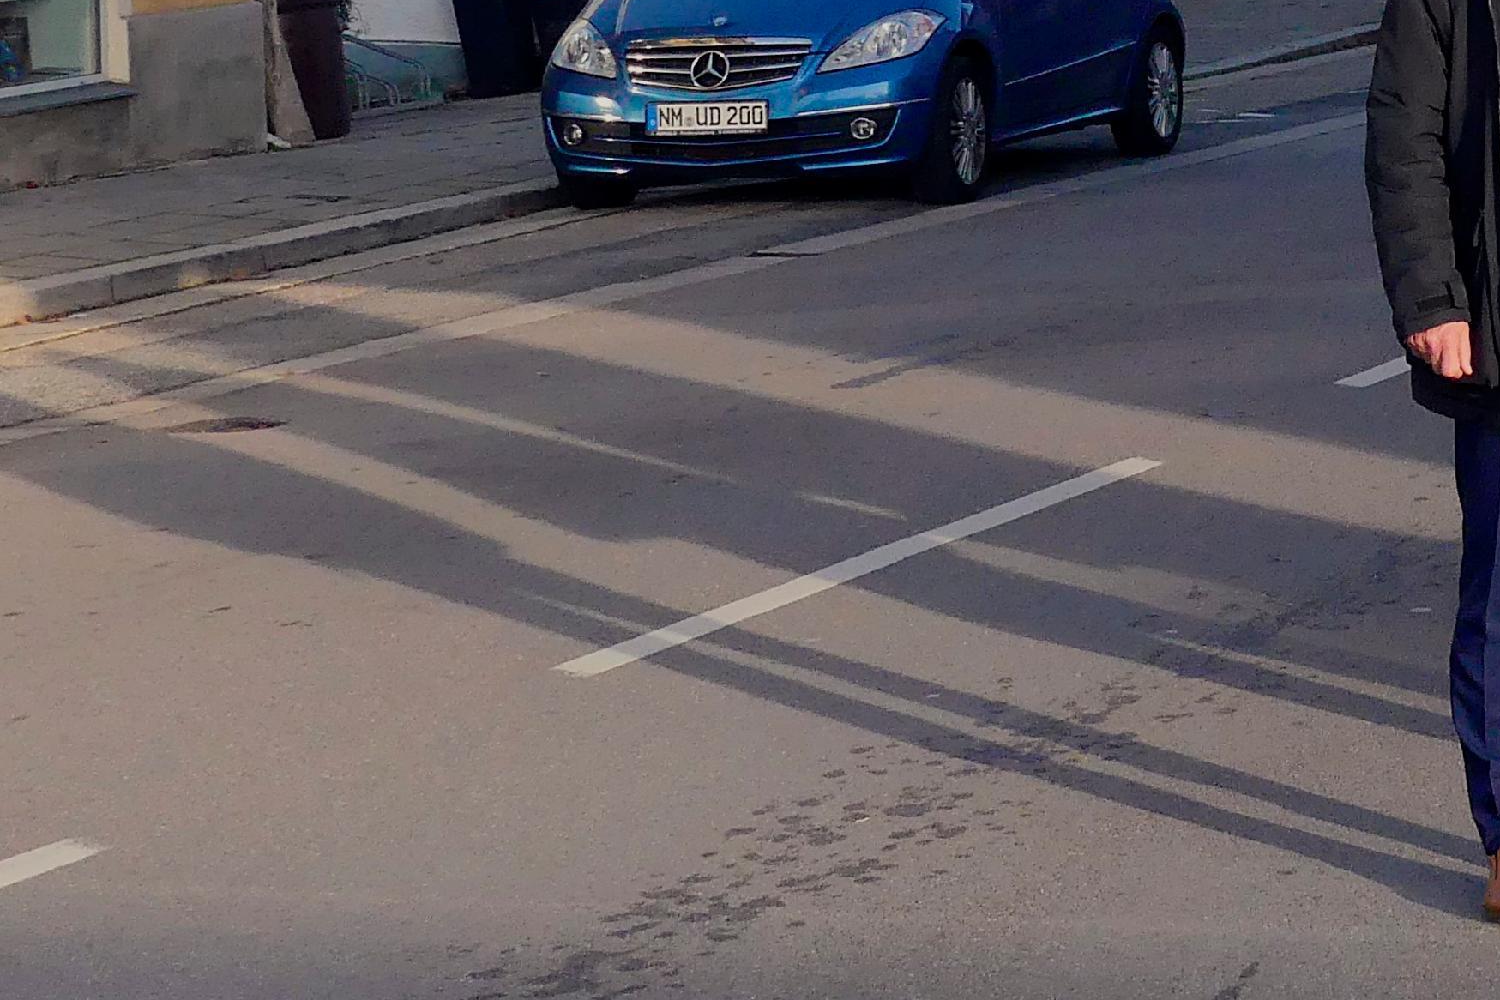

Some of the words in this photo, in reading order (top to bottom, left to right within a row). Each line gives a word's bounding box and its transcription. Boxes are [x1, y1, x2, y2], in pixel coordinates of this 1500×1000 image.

[659, 106, 683, 127] NM
[695, 106, 721, 126] UD
[726, 105, 763, 125] 200
